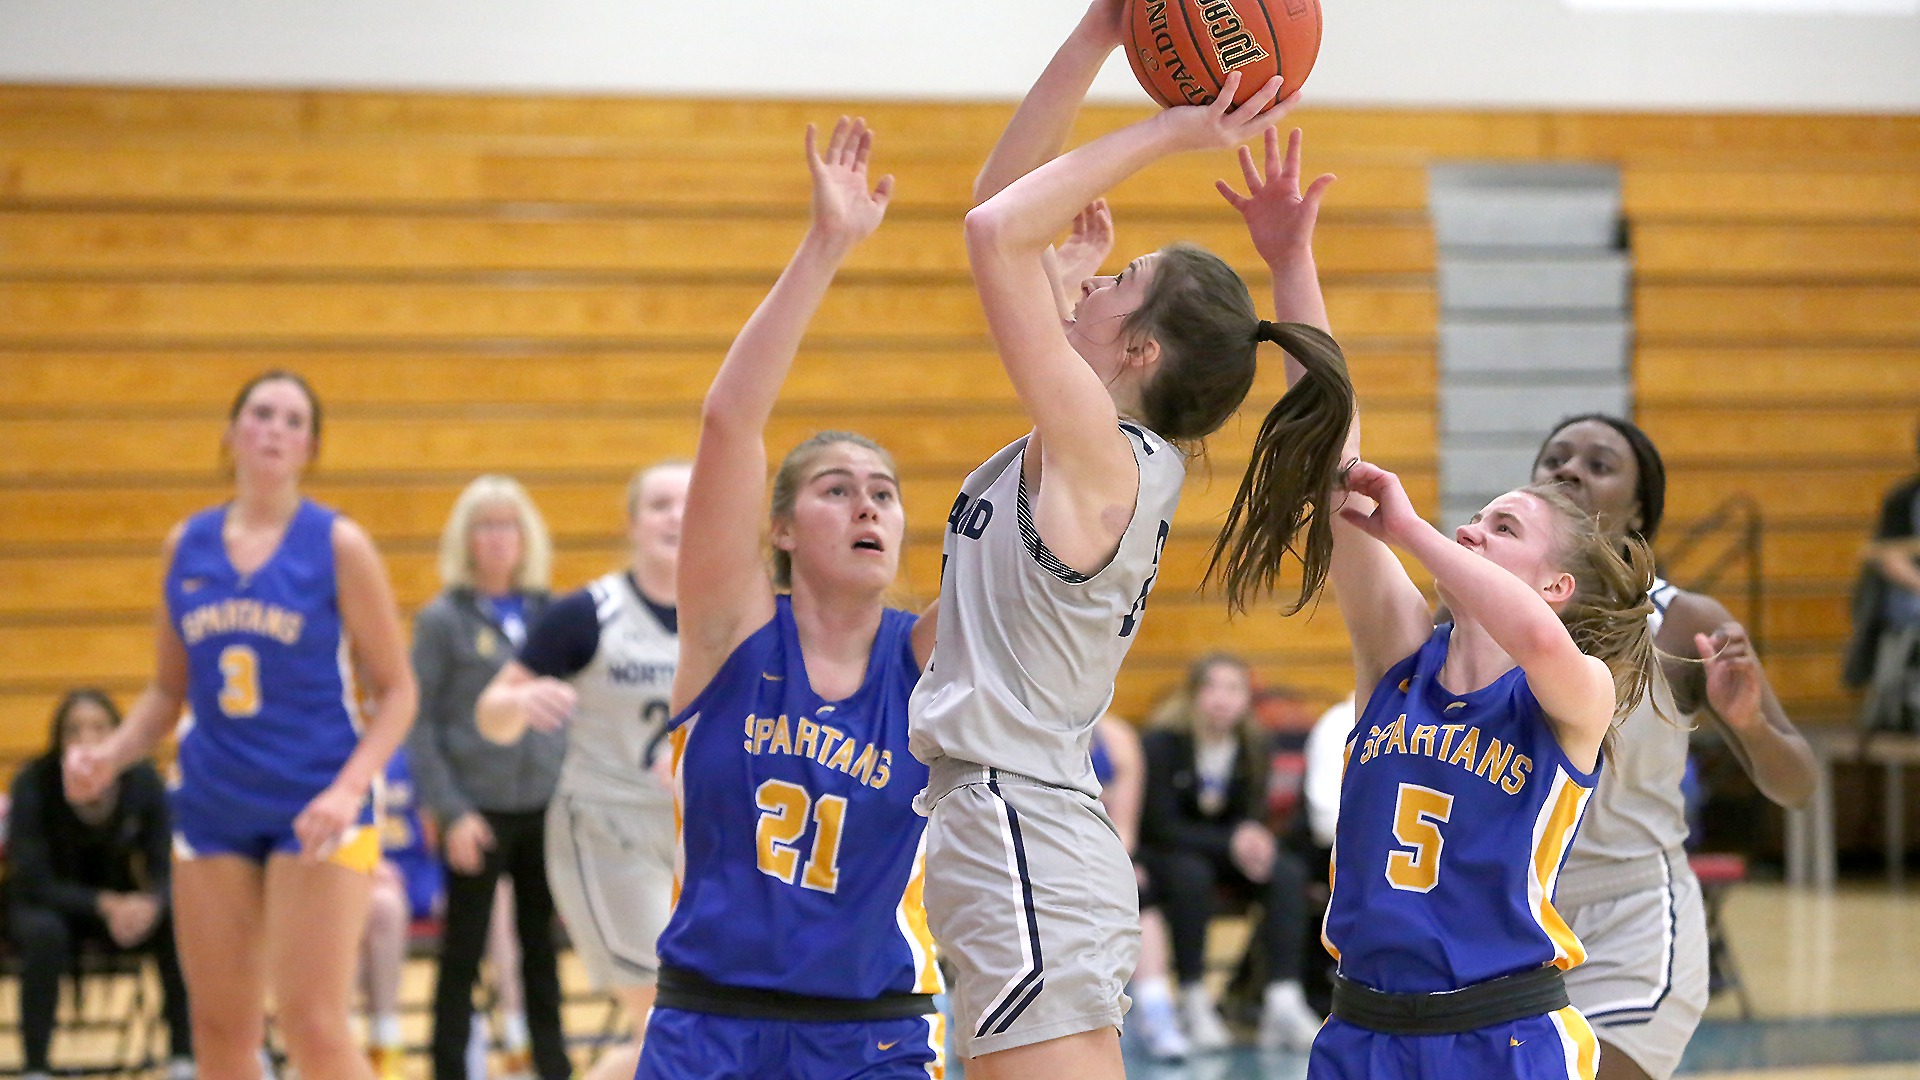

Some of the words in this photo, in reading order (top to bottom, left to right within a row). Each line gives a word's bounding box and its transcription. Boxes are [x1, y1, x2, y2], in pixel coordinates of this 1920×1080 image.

[1145, 0, 1217, 106] PALDIN
[182, 599, 304, 644] SPARTANS
[218, 645, 260, 716] 3
[744, 713, 892, 789] SPARTANS
[1359, 713, 1533, 796] SPARTANS
[755, 778, 847, 894] 21
[1385, 782, 1454, 894] 5
